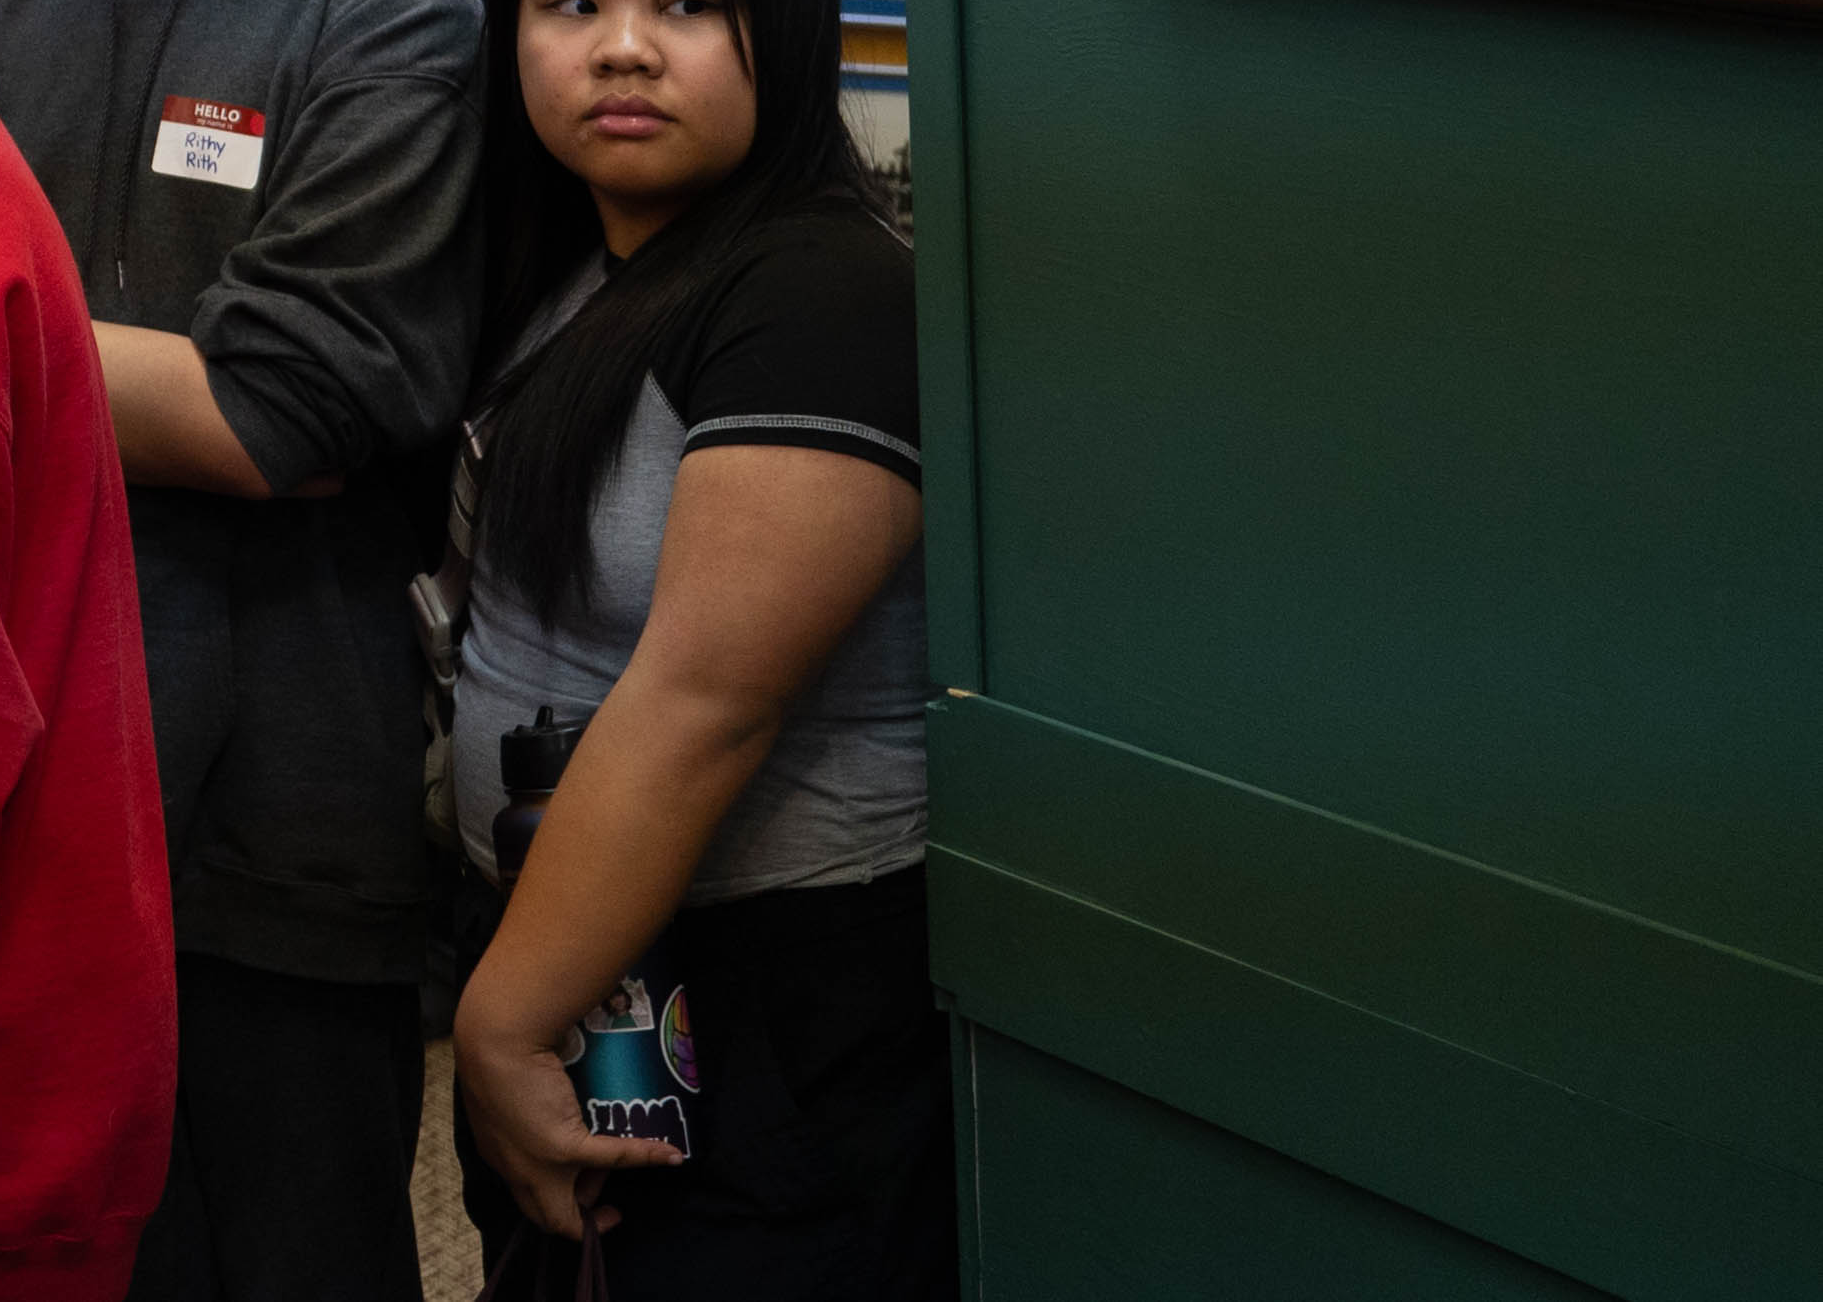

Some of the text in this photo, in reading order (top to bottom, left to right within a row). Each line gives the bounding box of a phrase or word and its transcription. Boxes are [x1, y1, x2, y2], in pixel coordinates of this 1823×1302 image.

[194, 102, 241, 123] HELLO
[185, 131, 226, 158] Rithy
[186, 151, 218, 174] Rith
